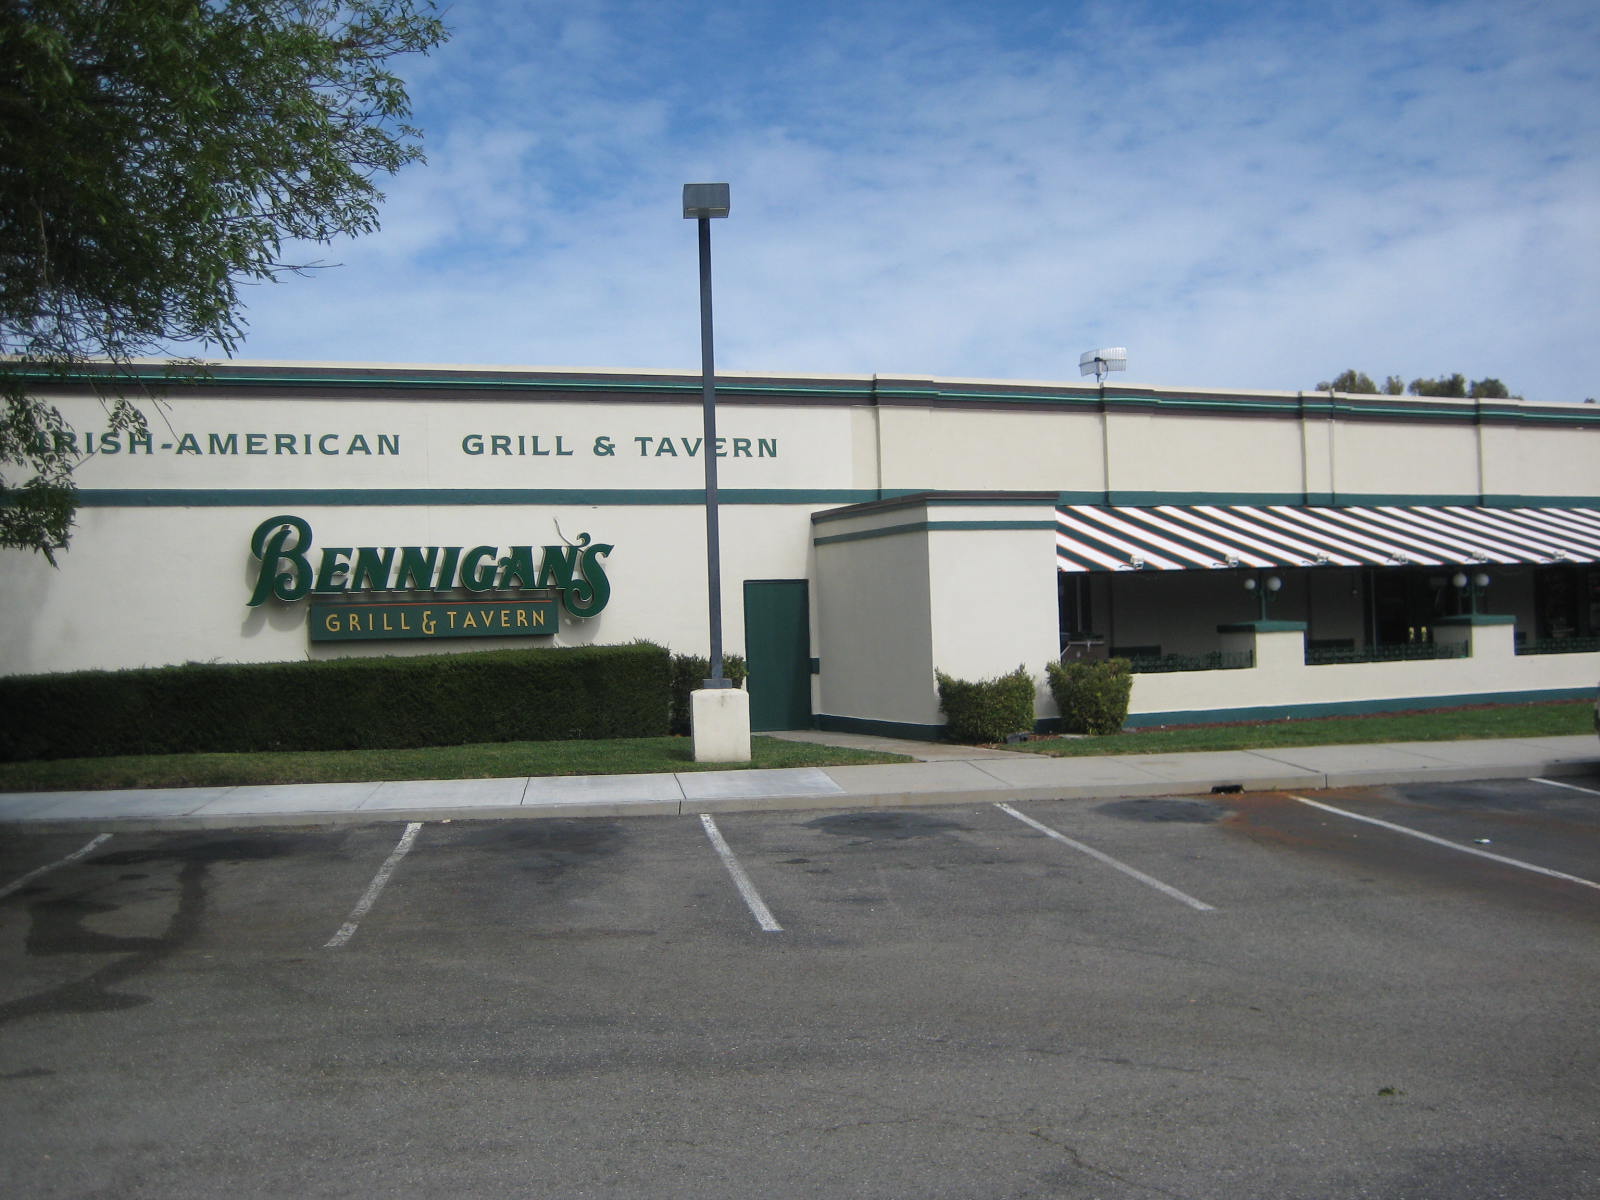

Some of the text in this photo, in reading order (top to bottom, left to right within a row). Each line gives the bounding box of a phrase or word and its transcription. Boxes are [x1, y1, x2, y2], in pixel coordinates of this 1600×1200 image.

[461, 434, 574, 456] GRILL
[592, 436, 615, 456] &
[634, 436, 777, 457] TAVERN
[246, 515, 614, 619] BENNIGAN'S
[325, 609, 545, 635] GRILL & TAVERN
